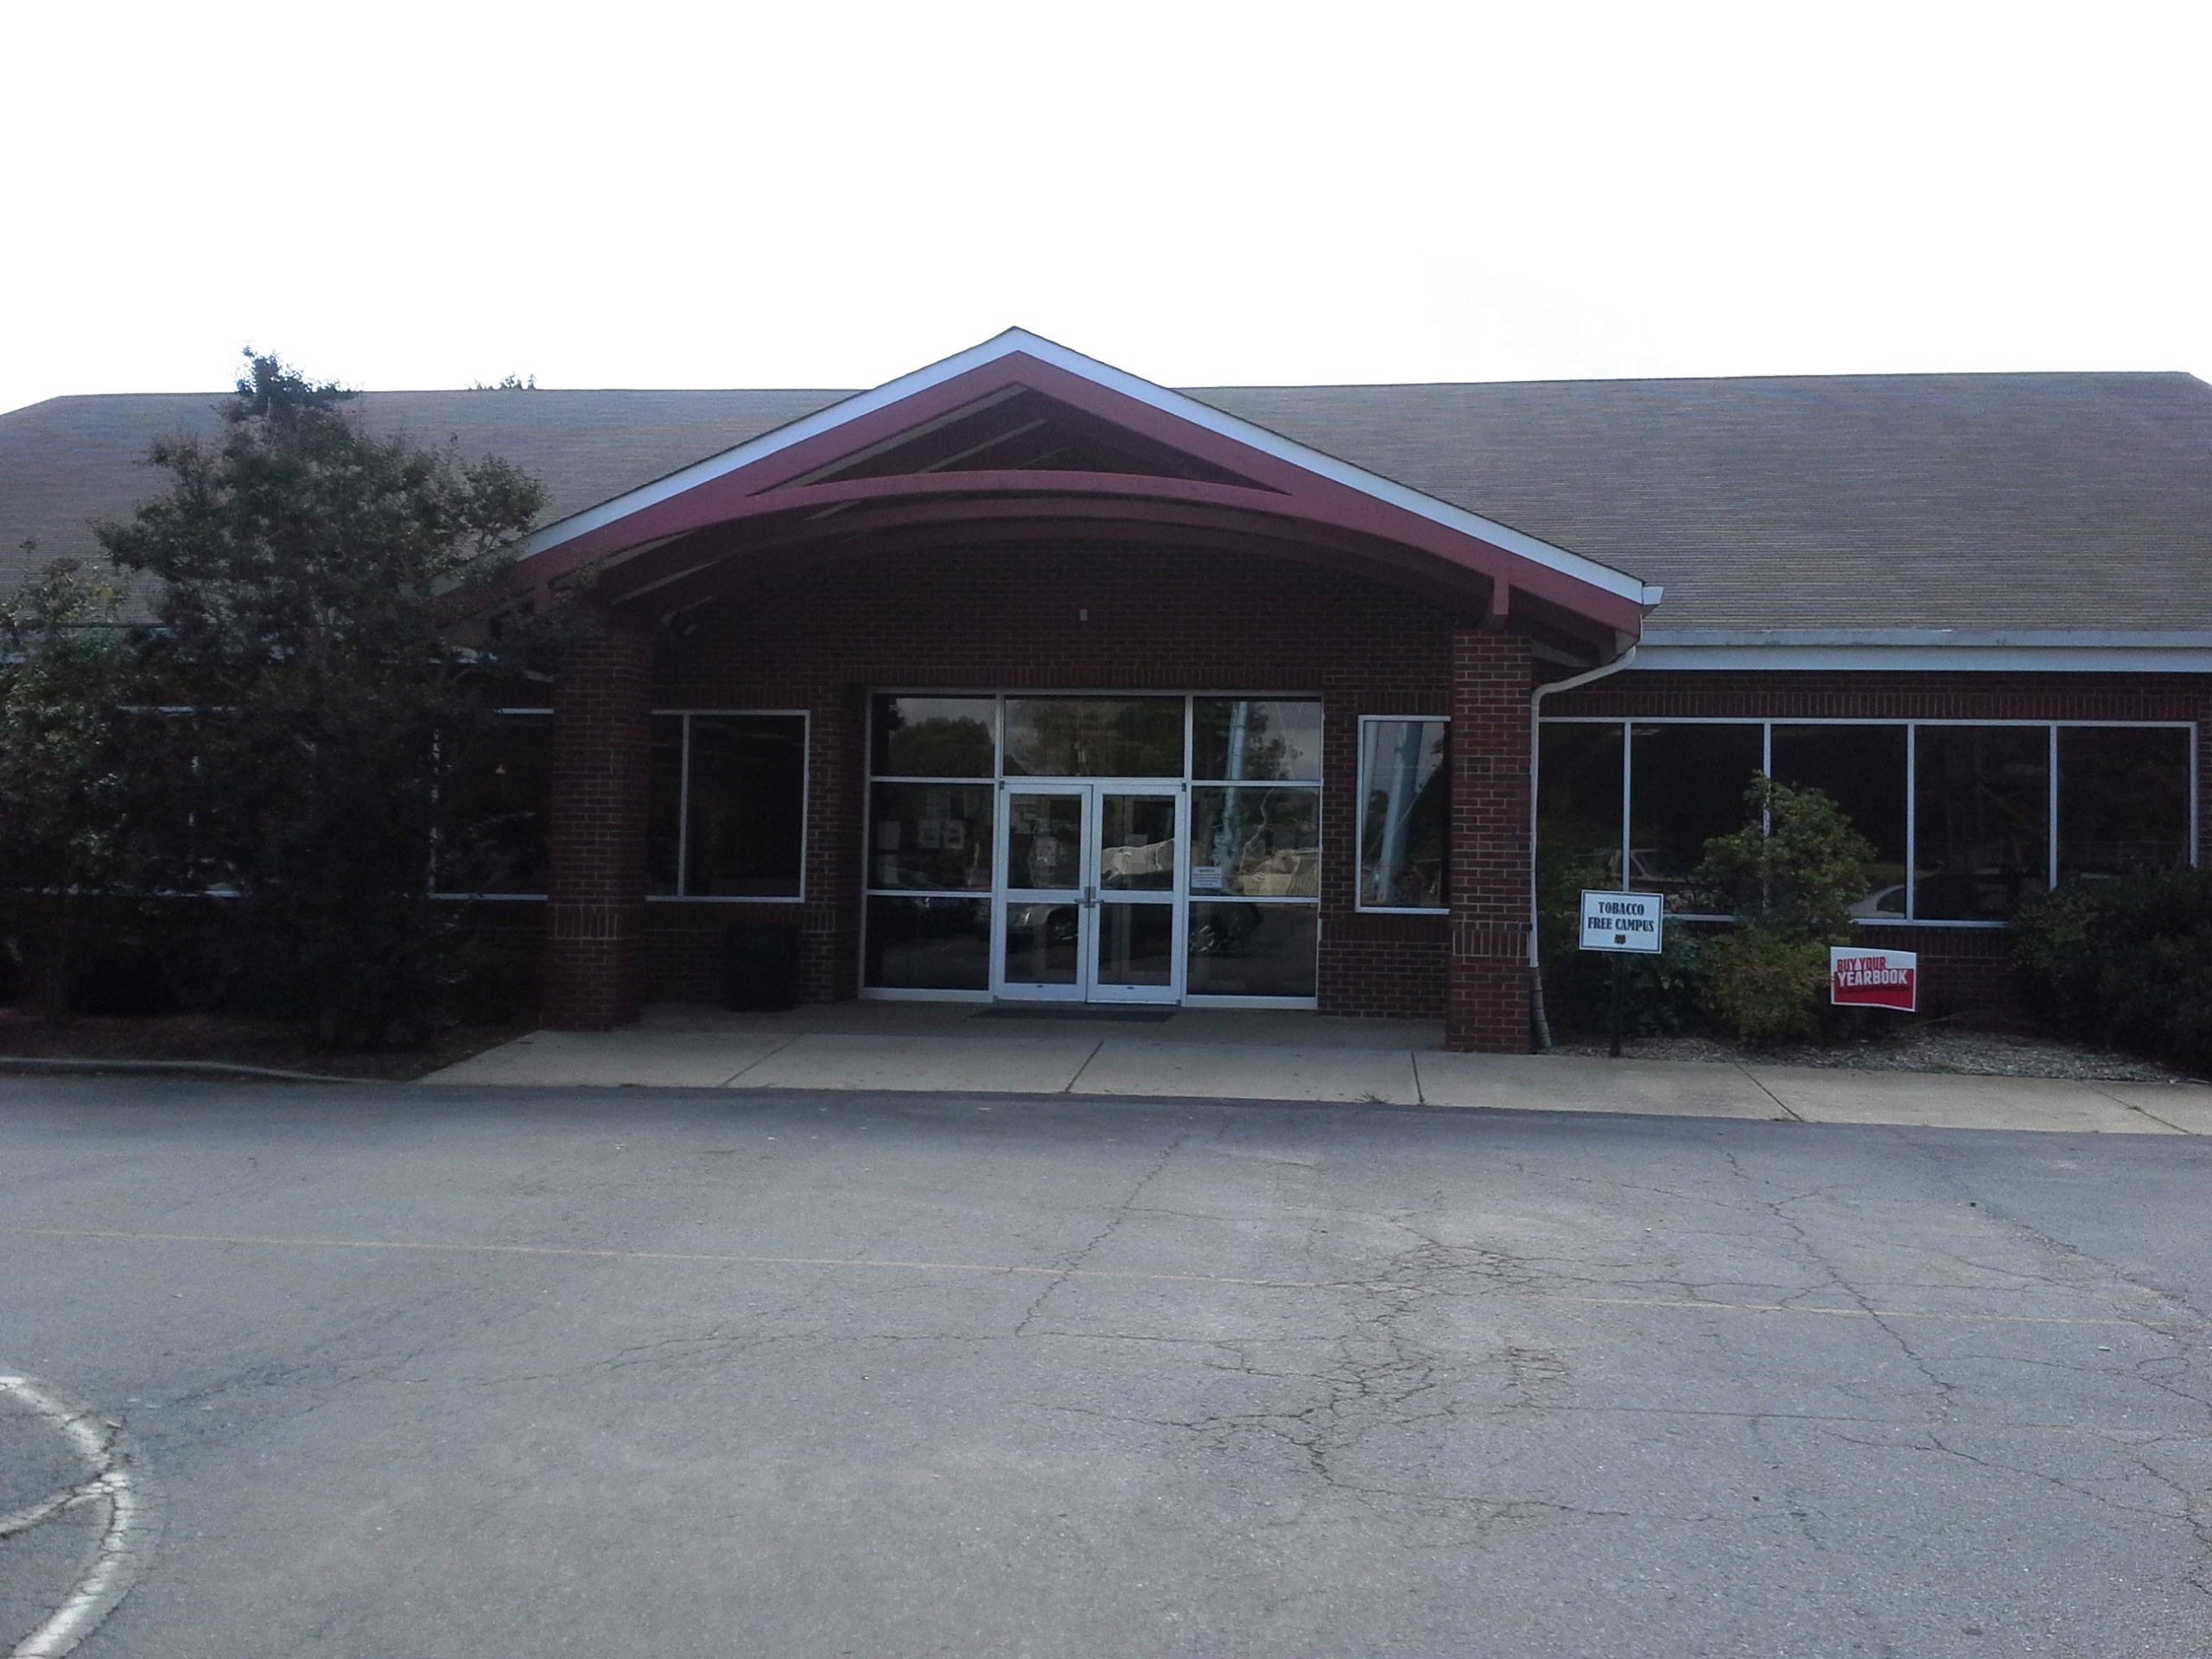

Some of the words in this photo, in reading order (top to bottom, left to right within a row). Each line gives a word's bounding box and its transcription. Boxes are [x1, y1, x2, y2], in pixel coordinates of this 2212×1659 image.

[1599, 901, 1644, 915] TOBACCO
[1587, 917, 1612, 930] FREE
[1615, 918, 1654, 932] CAMPUS
[1837, 957, 1857, 971] BUY
[1859, 957, 1885, 970] YOUR
[1838, 969, 1907, 987] YEARBOOK
